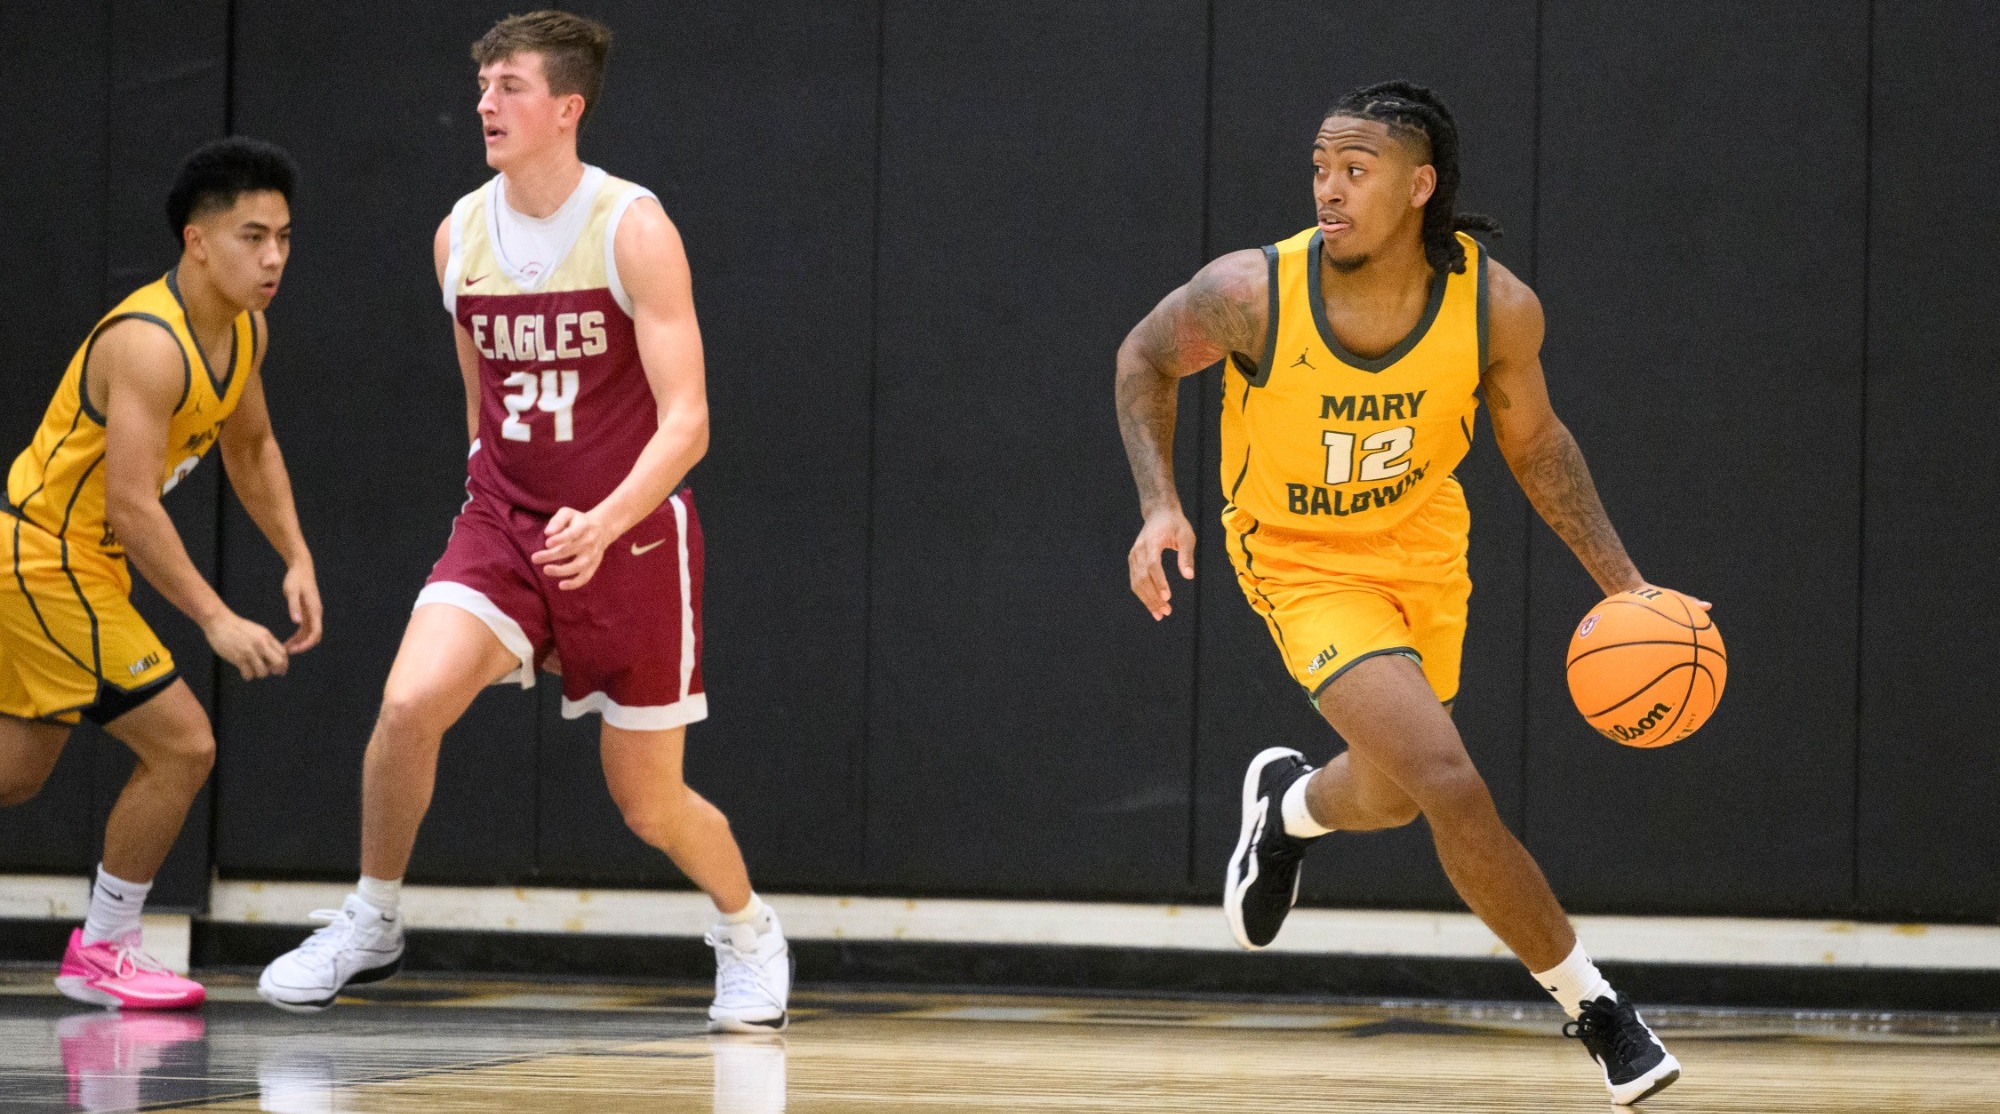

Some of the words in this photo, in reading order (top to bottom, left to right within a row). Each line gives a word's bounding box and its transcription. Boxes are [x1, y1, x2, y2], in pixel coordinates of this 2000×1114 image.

[471, 311, 608, 362] EAGLES
[501, 369, 580, 443] 24
[1318, 389, 1428, 422] MARY
[1321, 425, 1415, 486] 12
